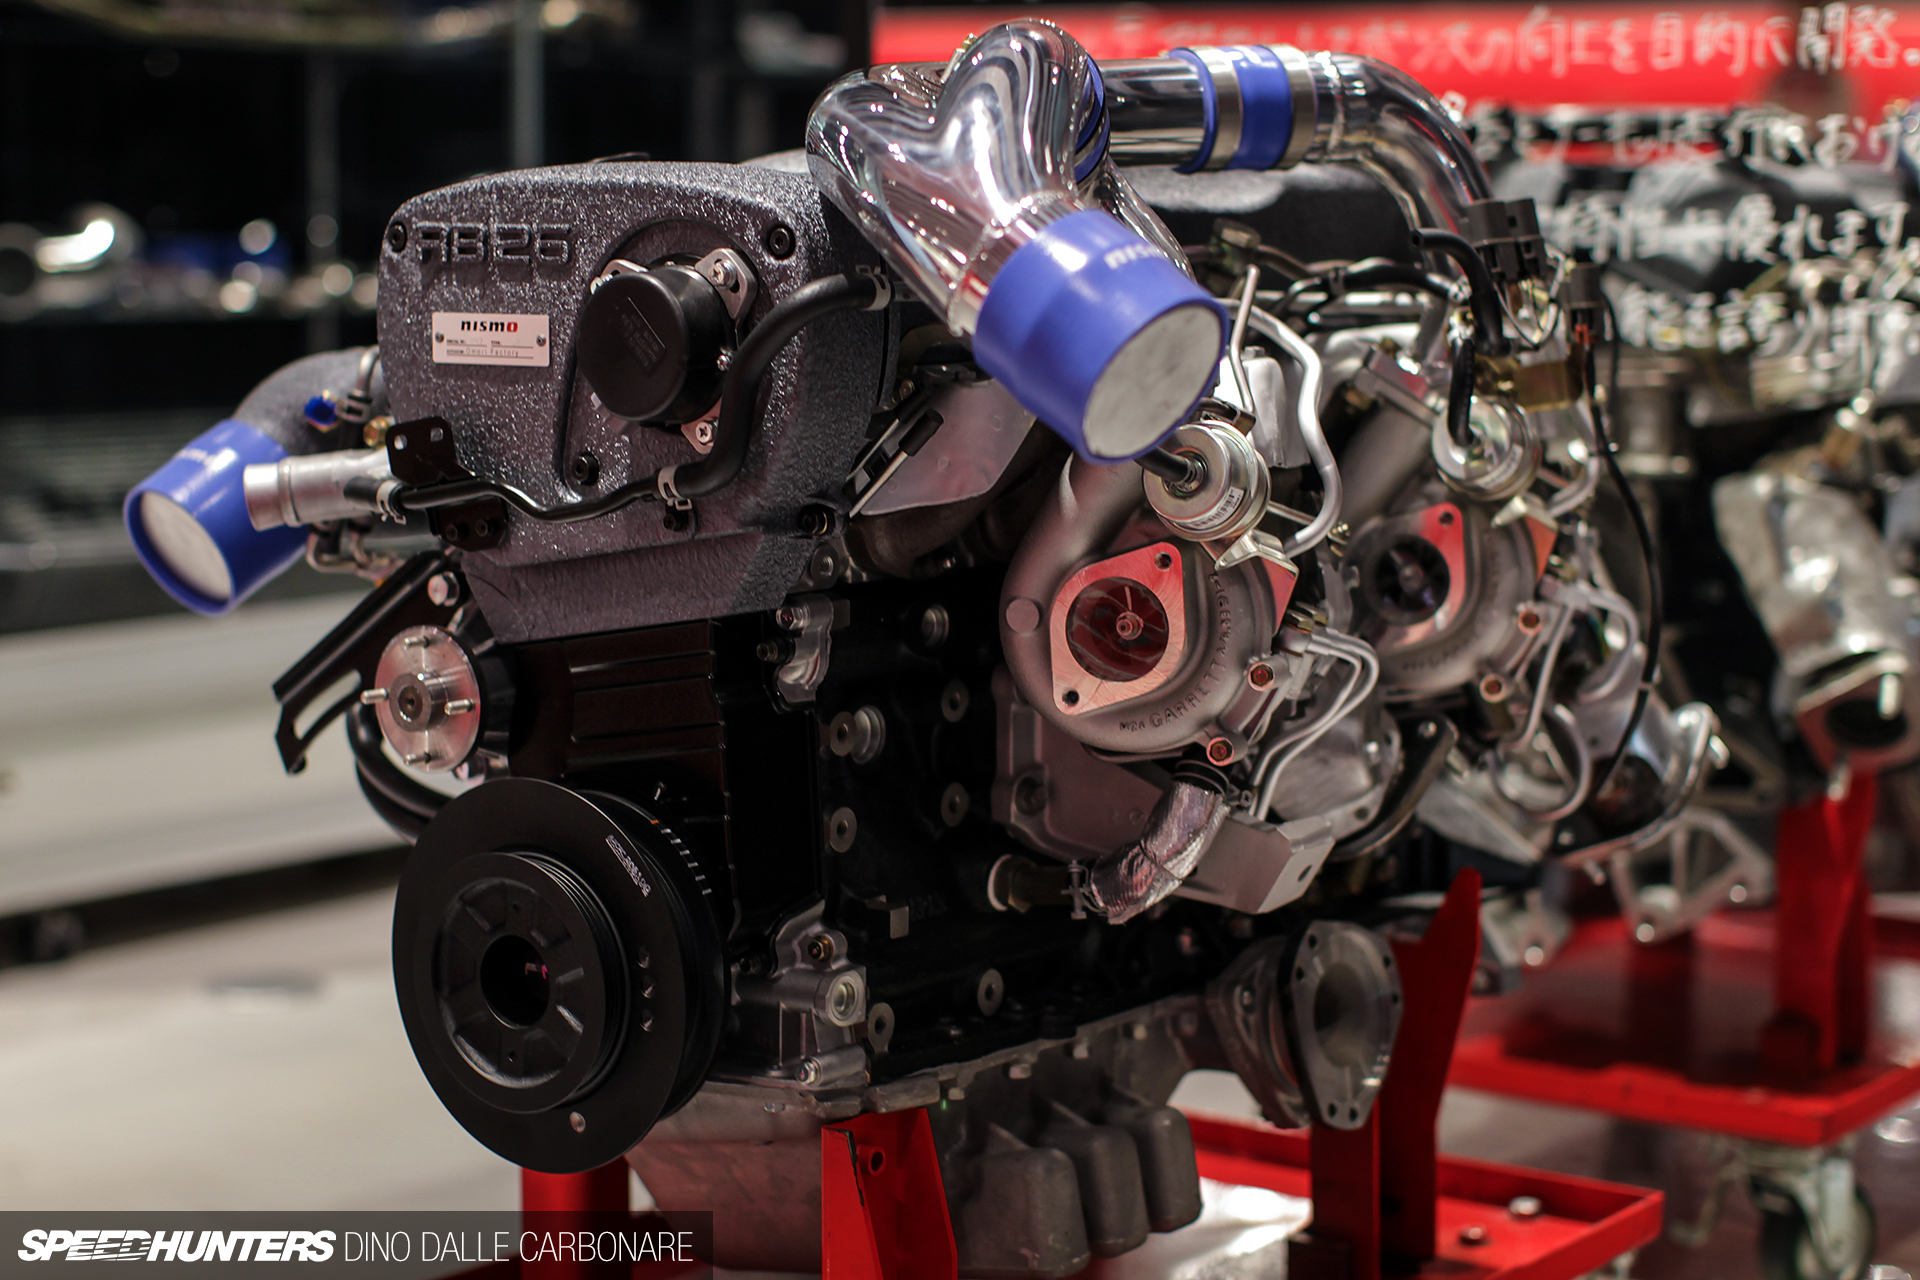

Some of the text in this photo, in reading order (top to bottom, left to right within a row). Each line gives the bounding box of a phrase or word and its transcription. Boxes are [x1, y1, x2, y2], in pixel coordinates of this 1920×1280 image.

[414, 220, 571, 263] RB26
[461, 320, 519, 333] nismo
[1149, 659, 1227, 729] GARRETT
